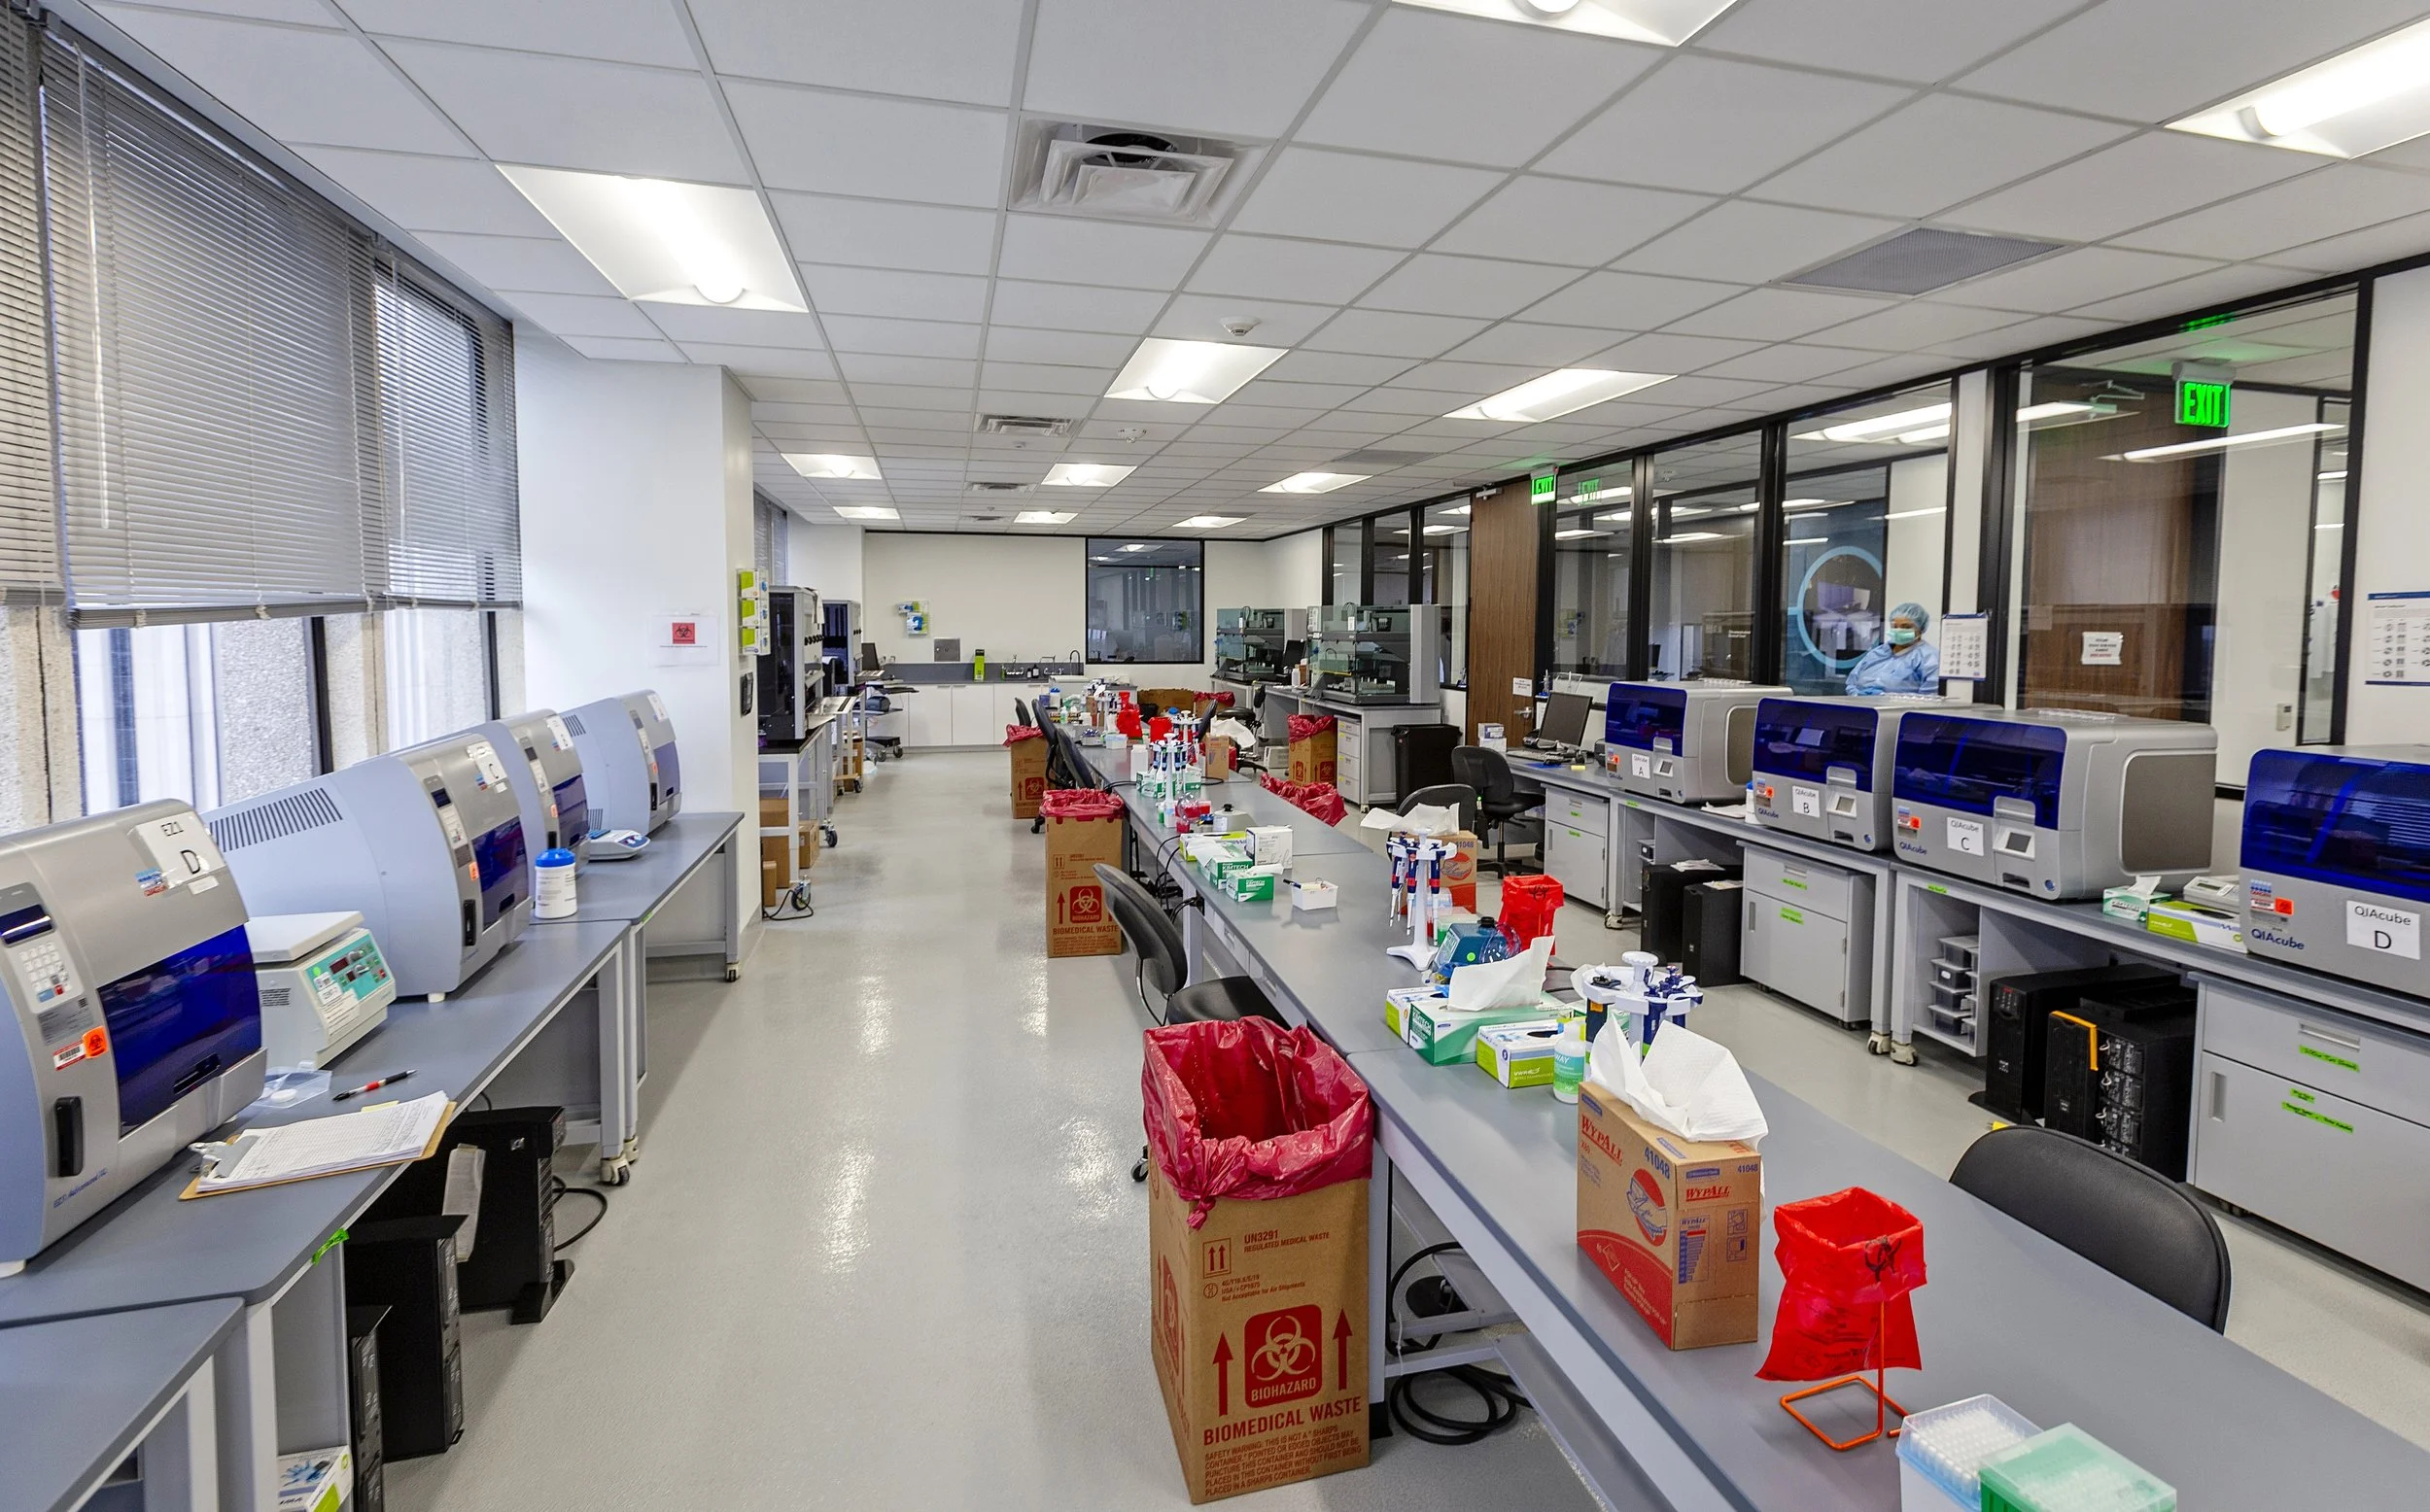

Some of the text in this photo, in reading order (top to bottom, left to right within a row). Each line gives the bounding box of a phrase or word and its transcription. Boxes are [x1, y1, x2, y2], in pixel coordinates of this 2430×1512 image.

[2183, 382, 2224, 425] EXIT
[1803, 802, 1810, 814] B
[160, 821, 185, 837] EZ1
[1950, 819, 1980, 832] QIAcube
[1899, 842, 1927, 855] QIAcube
[1961, 837, 1970, 851] C
[180, 848, 201, 875] D
[2354, 905, 2412, 926] QIAcube
[1053, 924, 1119, 935] BIOMEDICAL WASTE
[2251, 928, 2306, 950] QIAcube
[2374, 930, 2392, 949] D
[1581, 1114, 1623, 1164] WYPALL
[1645, 1146, 1671, 1180] 41048
[1737, 1163, 1758, 1174] 41048
[1685, 1186, 1731, 1201] WYPALL
[1243, 1231, 1331, 1254] REGULATED MEDICAL WASTE
[1244, 1229, 1279, 1245] UN3291
[1250, 1377, 1317, 1402] BIOHAZARD
[1203, 1395, 1362, 1446] BIOMEDICAL WASTE
[1205, 1448, 1231, 1460] SAFETY
[1266, 1436, 1280, 1447] THIS
[1280, 1435, 1288, 1445] IS
[1288, 1432, 1302, 1442] NOT
[1248, 1447, 1276, 1459] POINTED
[1277, 1444, 1287, 1454] OR
[1288, 1439, 1310, 1451] EDGED
[1311, 1432, 1339, 1446] OBJECTS
[1341, 1429, 1354, 1439] MAY
[1205, 1436, 1360, 1478] PUNCTURE THIS CONTAINER AND SHOULD NOT BE
[1205, 1444, 1362, 1489] PLACED IN THIS CONTAINER WITHOUT FIRST BEING
[1205, 1484, 1232, 1496] PLACED
[1232, 1482, 1240, 1491] IN
[1246, 1474, 1273, 1487] SHARPS
